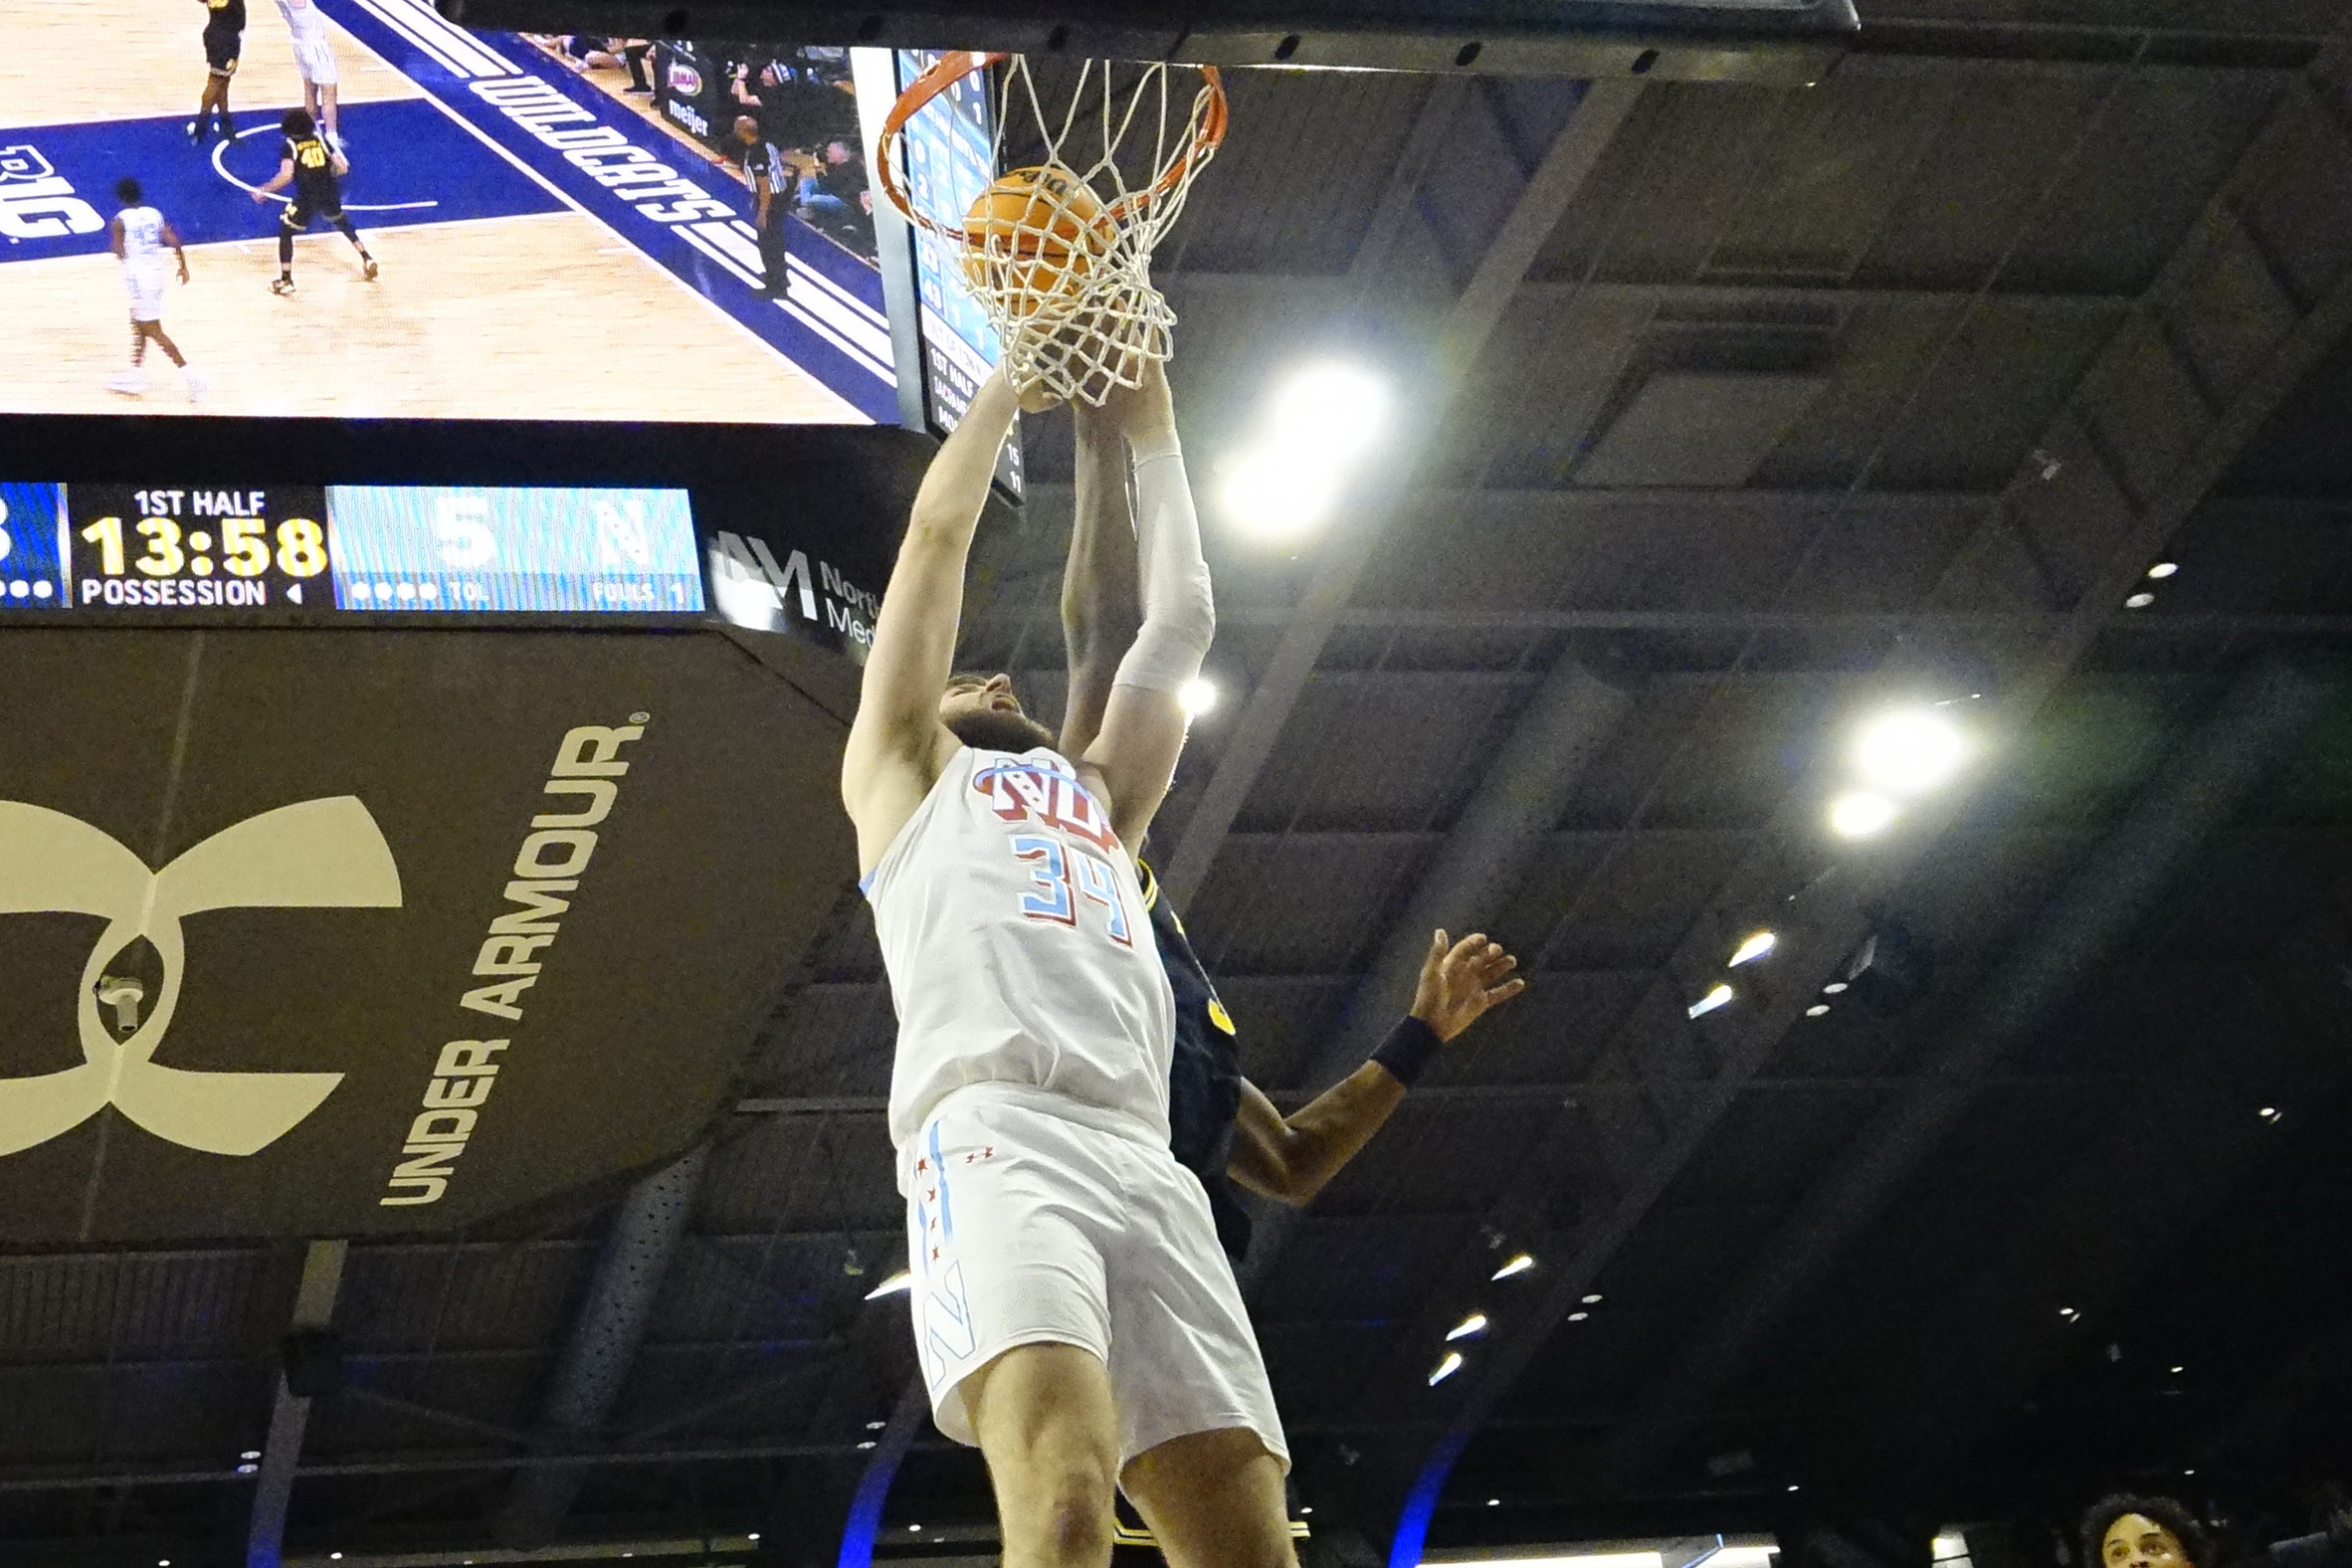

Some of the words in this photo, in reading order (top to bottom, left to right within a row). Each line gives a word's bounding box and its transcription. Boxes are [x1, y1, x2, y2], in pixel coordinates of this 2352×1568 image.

[669, 98, 708, 136] meijer
[301, 146, 325, 168] 40
[468, 76, 736, 222] WILDCATS
[930, 347, 947, 376] 1ST
[134, 490, 185, 515] 1ST
[193, 490, 266, 515] HALF
[82, 516, 328, 577] 13:58
[437, 496, 497, 569] 5
[595, 498, 650, 565] N
[82, 579, 267, 606] POSSESSION
[592, 582, 654, 603] FOULS
[1008, 834, 1134, 949] 34
[379, 1038, 510, 1206] UNDER
[460, 724, 646, 1021] ARMOUR
